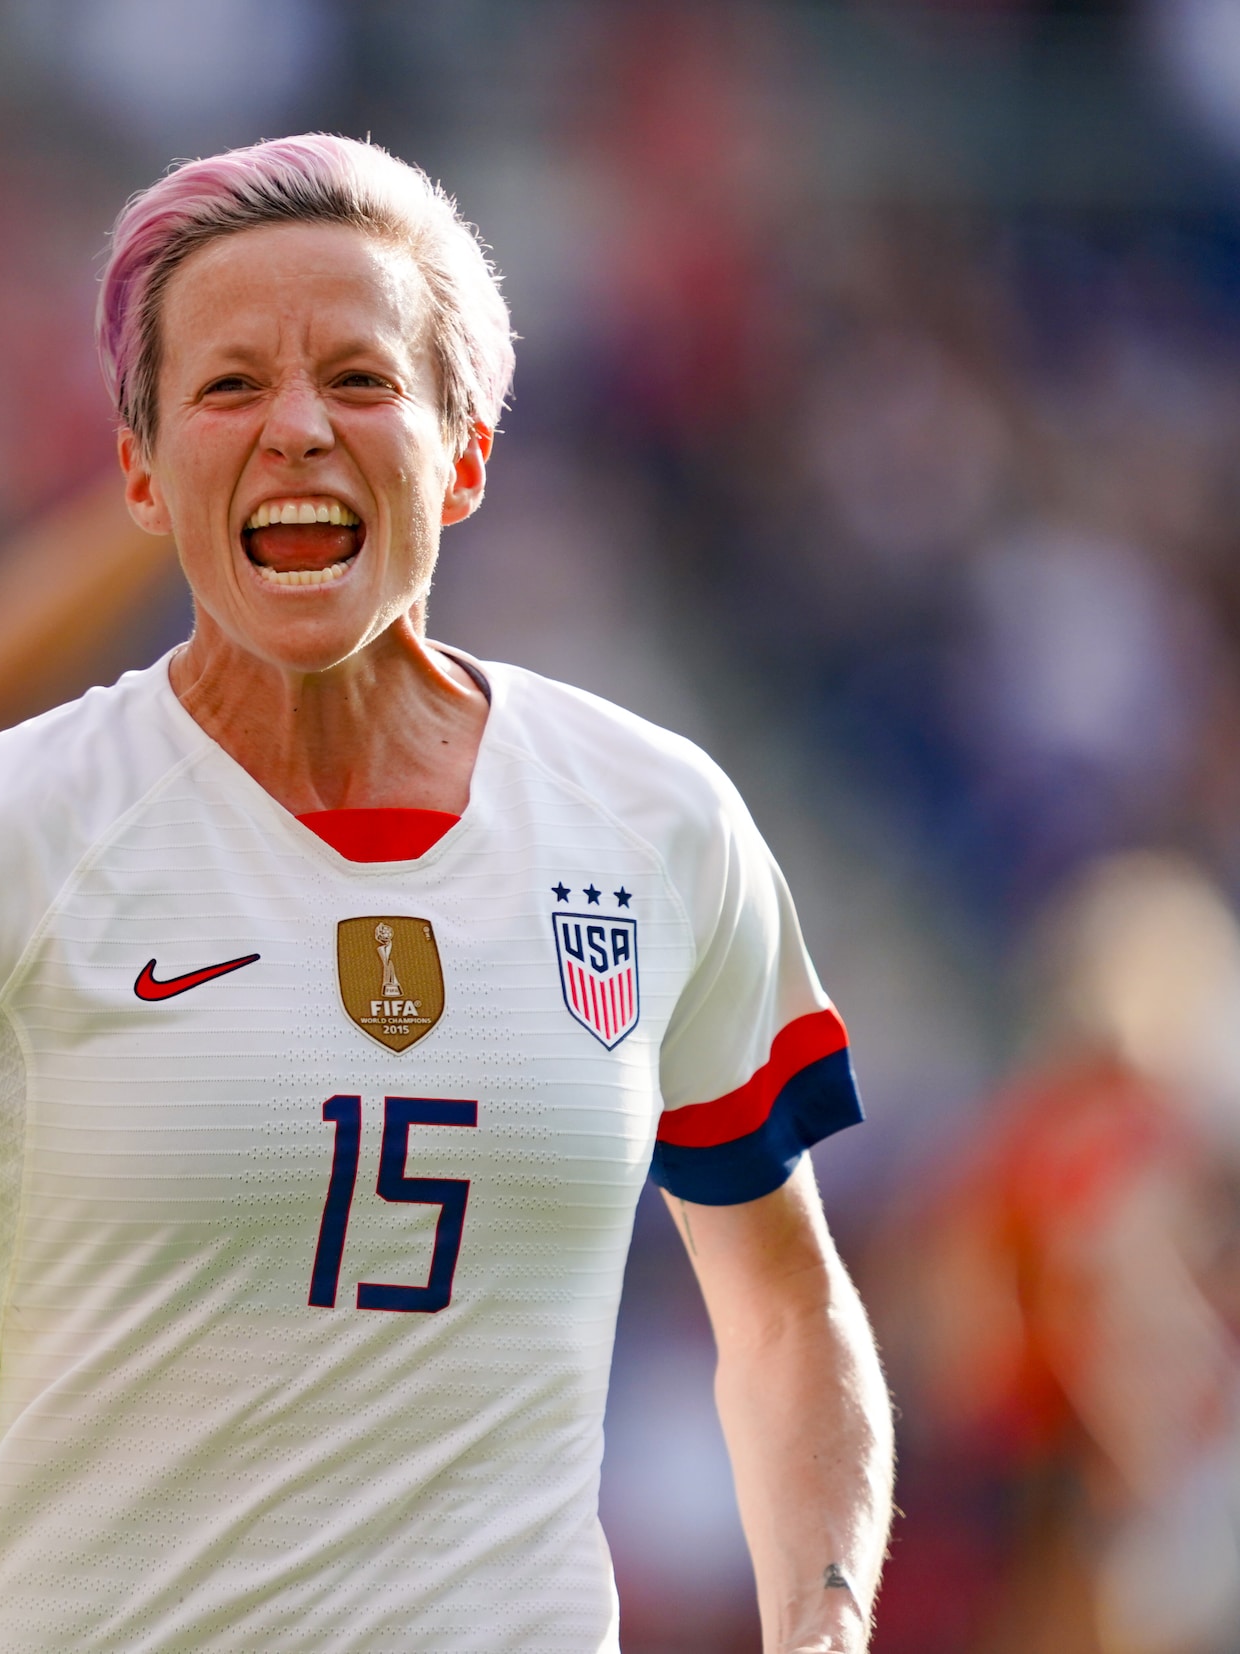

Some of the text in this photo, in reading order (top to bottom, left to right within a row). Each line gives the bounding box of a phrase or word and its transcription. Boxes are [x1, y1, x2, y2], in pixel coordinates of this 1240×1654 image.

[562, 923, 629, 973] USA
[383, 1025, 410, 1035] 2015
[308, 1094, 478, 1313] 15
